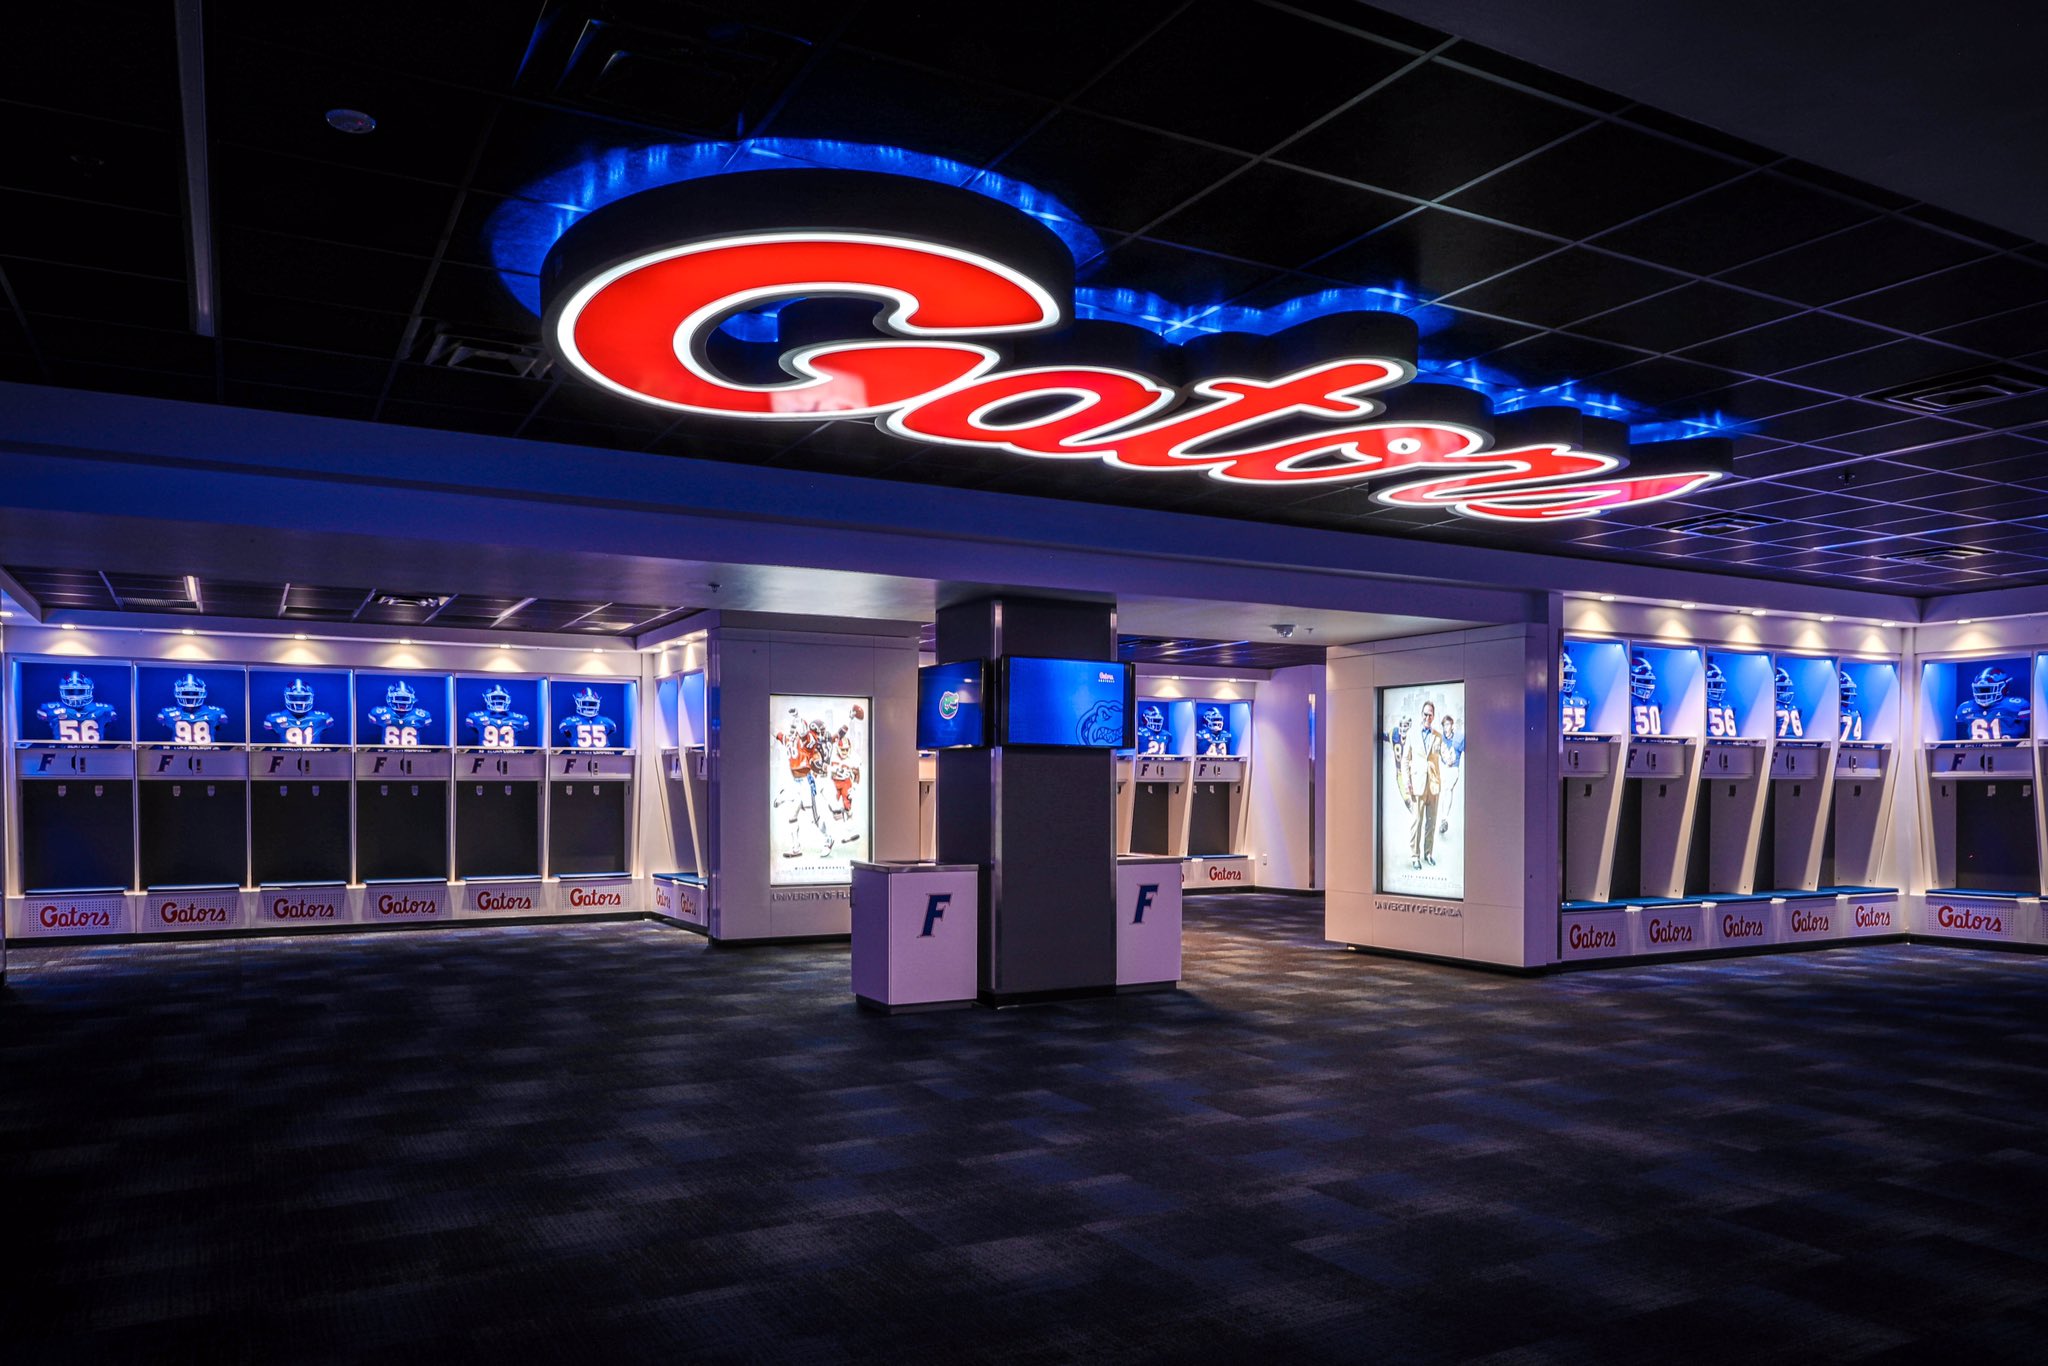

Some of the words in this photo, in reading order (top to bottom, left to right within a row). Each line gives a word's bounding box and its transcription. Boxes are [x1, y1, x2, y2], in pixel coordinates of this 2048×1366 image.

[556, 232, 1724, 523] Gators
[59, 720, 101, 741] 56
[1633, 705, 1662, 735] 50
[1708, 707, 1737, 736] 56
[1776, 709, 1803, 737] 76
[1971, 718, 2001, 740] 61
[174, 721, 212, 744] 98
[285, 727, 313, 744] 91
[384, 726, 418, 745] 66
[482, 725, 515, 747] 93
[577, 724, 608, 748] 55
[38, 753, 56, 772] F
[157, 754, 174, 772] F
[268, 755, 284, 773] F
[373, 756, 388, 773] F
[471, 757, 485, 774] F
[563, 758, 577, 774] F
[1209, 866, 1242, 881] Gators
[273, 898, 335, 919] Gators
[379, 894, 437, 915] Gators
[476, 891, 532, 911] Gators
[569, 887, 622, 909] Gators
[1130, 883, 1160, 925] F
[40, 905, 110, 928] Gators
[160, 901, 226, 924] Gators
[917, 892, 953, 938] F
[1791, 909, 1829, 933] Gators
[1855, 905, 1891, 928] Gators
[1937, 905, 2002, 932] Gators
[1569, 923, 1616, 950] Gators
[1649, 918, 1692, 944] Gators
[1723, 914, 1763, 938] Gators
